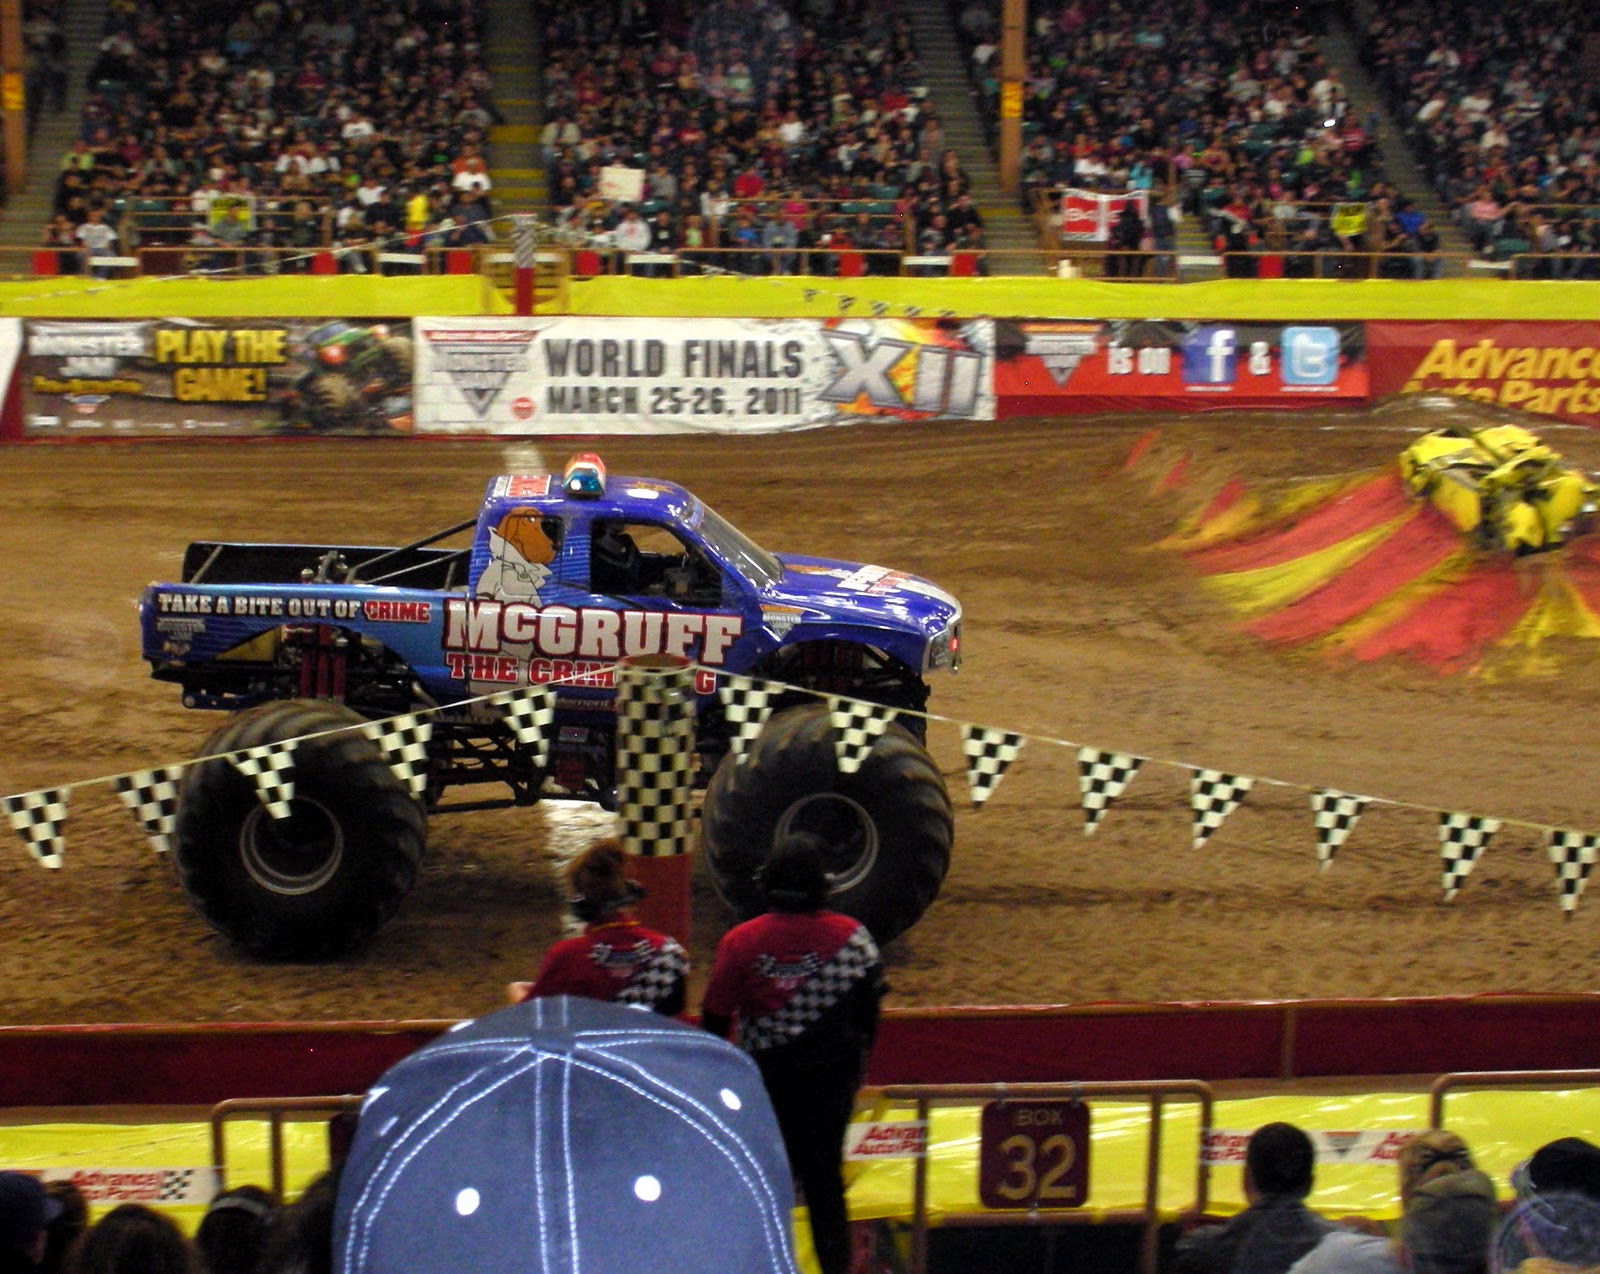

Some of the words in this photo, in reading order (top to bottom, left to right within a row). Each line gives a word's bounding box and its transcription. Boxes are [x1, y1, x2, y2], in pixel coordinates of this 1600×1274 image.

[154, 329, 228, 363] PLAY
[233, 329, 288, 363] THE
[544, 338, 666, 378] WORLD
[684, 338, 803, 379] FINALS
[174, 368, 267, 401] GAME!
[545, 386, 640, 415] MARCH
[746, 386, 801, 415] 2011
[158, 593, 212, 614] TAKE
[215, 595, 230, 614] A
[234, 596, 283, 616] BITE
[288, 598, 332, 617] OUT
[334, 600, 361, 618] OF
[364, 600, 432, 622] CRIME
[446, 652, 520, 683] THE
[529, 656, 617, 689] CRIM
[1016, 1109, 1064, 1126] BOX
[996, 1133, 1077, 1200] 32
